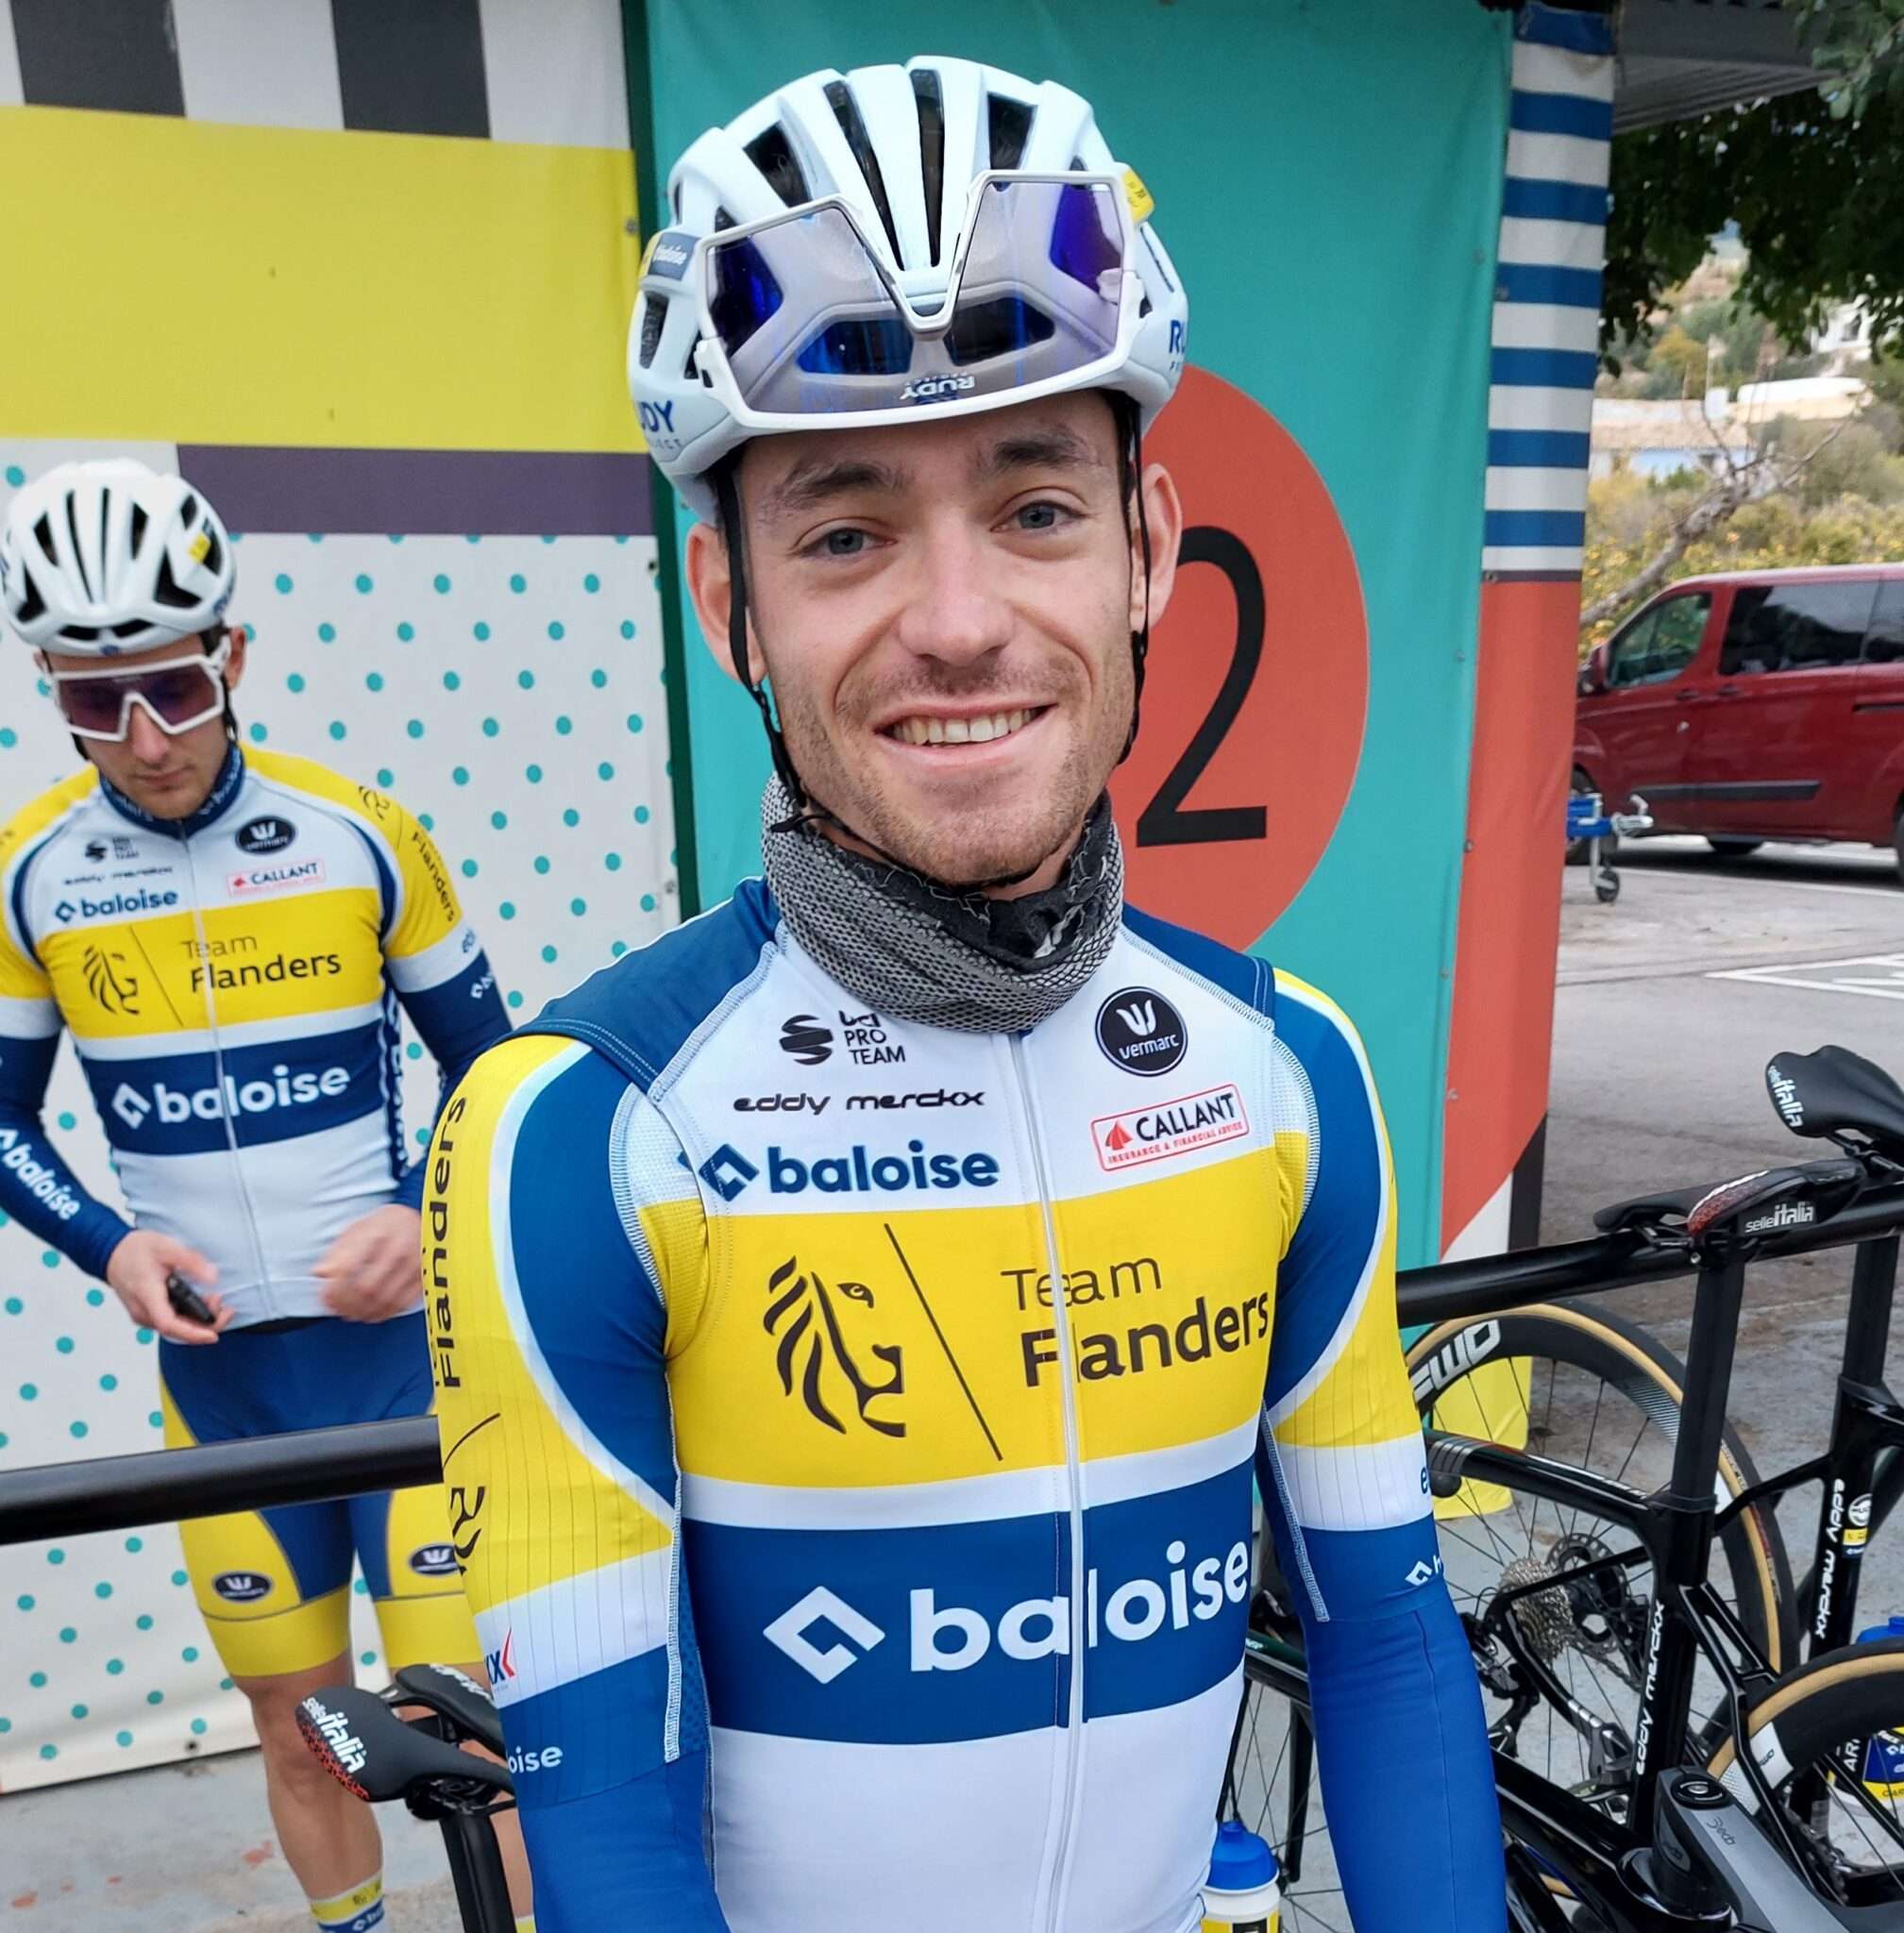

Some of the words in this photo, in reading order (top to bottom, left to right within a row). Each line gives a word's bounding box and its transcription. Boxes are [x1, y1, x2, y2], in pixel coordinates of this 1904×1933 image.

[899, 375, 975, 400] RUDY
[638, 399, 675, 433] DY
[250, 862, 318, 885] CALLANT
[80, 888, 179, 918] baloise
[191, 953, 342, 994] Flanders
[843, 1028, 887, 1047] PRO
[849, 1045, 907, 1066] TEAM
[1118, 1034, 1180, 1060] vermarc
[153, 1063, 351, 1124] baloise
[733, 1092, 832, 1117] eddy
[845, 1087, 986, 1111] merckx
[1136, 1091, 1236, 1142] CALLANT
[1, 1143, 81, 1221] baloise
[767, 1138, 1001, 1194] baloise
[428, 1095, 468, 1389] Flanders
[1000, 1257, 1163, 1311] Team
[1020, 1290, 1269, 1388] Fanders
[1644, 1598, 1665, 1702] merckx
[507, 1745, 564, 1774] oise
[1636, 1706, 1654, 1776] eddy
